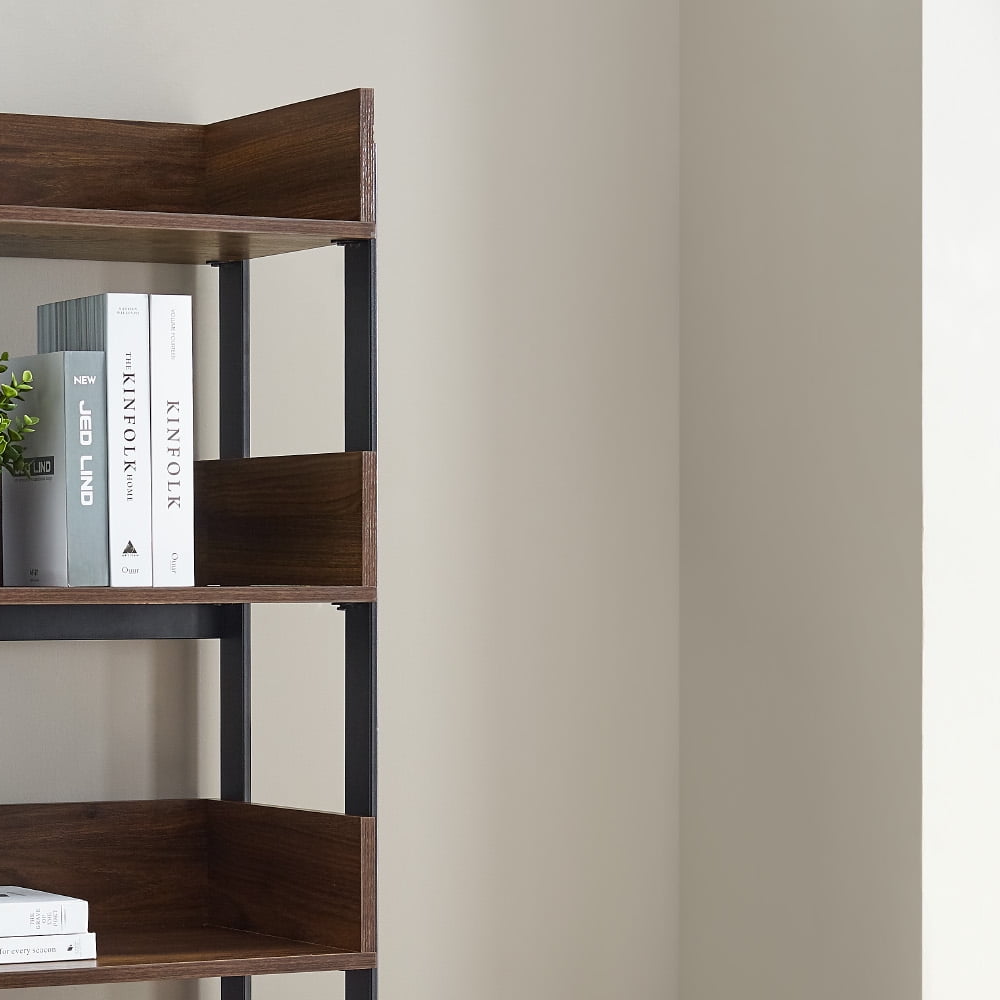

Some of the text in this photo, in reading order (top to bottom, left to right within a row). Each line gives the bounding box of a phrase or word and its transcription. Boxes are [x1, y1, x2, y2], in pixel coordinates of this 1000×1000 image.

[73, 375, 97, 385] NEW
[123, 372, 136, 473] KINFOLK
[33, 460, 51, 473] LIND
[79, 399, 94, 506] JED LIND
[166, 400, 181, 510] KINFOLK
[0, 947, 10, 955] for
[11, 948, 31, 956] every
